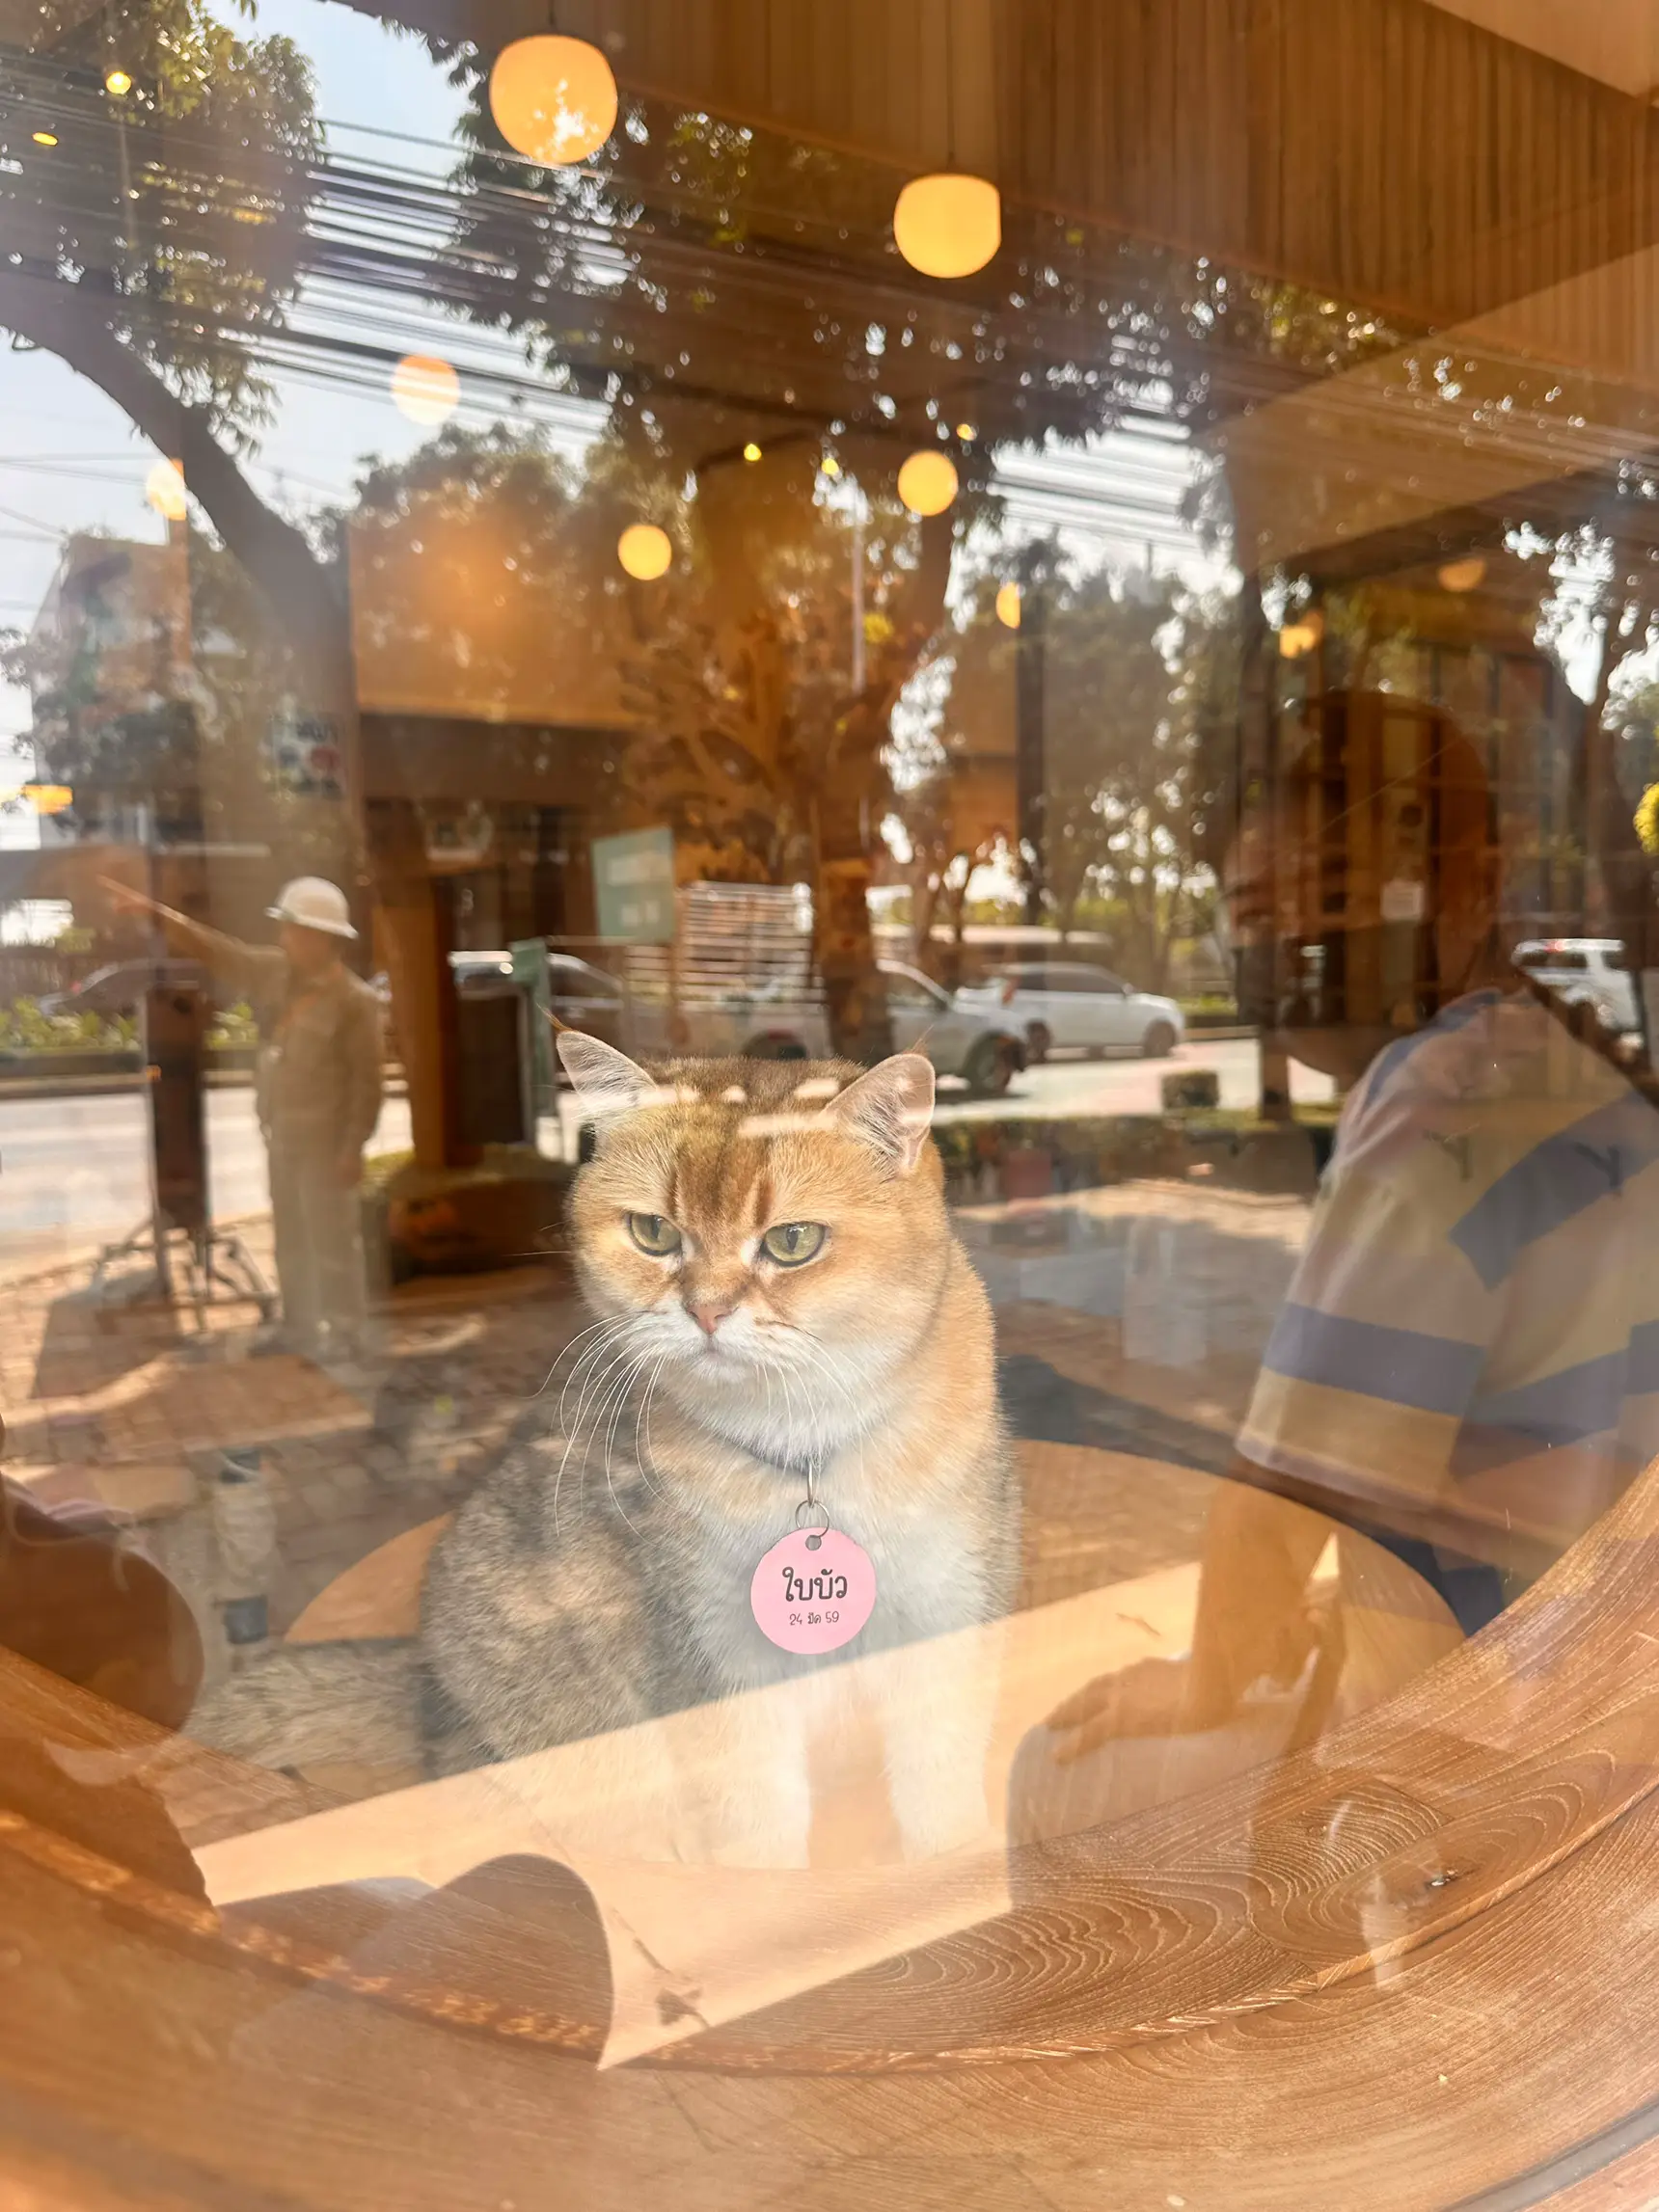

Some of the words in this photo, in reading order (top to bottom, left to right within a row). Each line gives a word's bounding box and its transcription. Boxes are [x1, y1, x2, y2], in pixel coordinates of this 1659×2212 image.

[782, 1566, 848, 1602] ใบบัว
[789, 1613, 802, 1626] 24
[825, 1611, 840, 1624] 59
